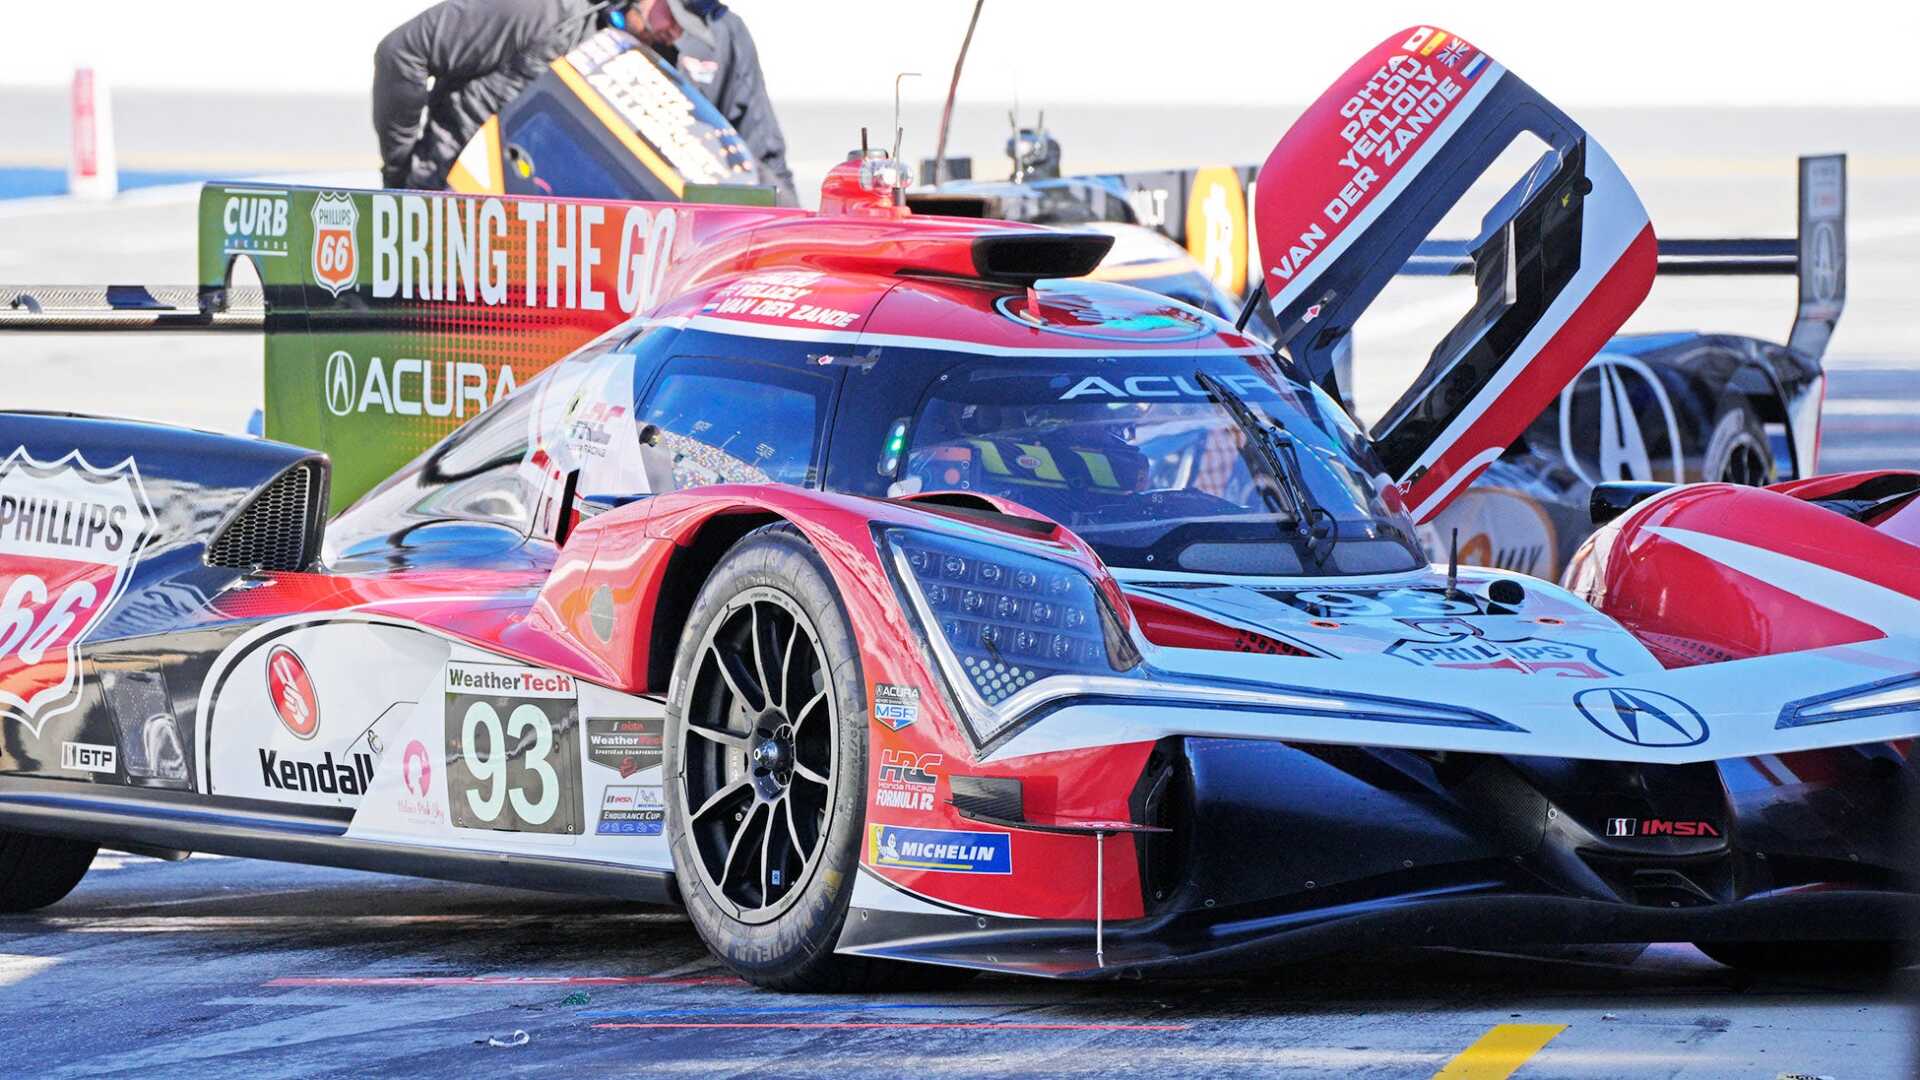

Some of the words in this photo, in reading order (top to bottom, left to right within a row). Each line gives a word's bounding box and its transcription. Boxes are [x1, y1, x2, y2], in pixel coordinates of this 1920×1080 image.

[1340, 54, 1409, 118] OHTA
[1340, 57, 1422, 143] PALOU
[1338, 65, 1437, 170] YELLOLY
[1270, 223, 1327, 280] VAN
[1323, 165, 1379, 224] DER
[1376, 76, 1462, 166] ZANDE
[223, 196, 288, 236] CURB
[318, 207, 351, 226] PHILLIPS
[320, 235, 350, 272] 66
[372, 194, 507, 306] BRING
[518, 200, 605, 311] THE
[716, 297, 755, 314] VAN
[750, 301, 795, 317] DER
[788, 304, 860, 328] ZANDE
[357, 356, 518, 418] ACURA
[0, 494, 127, 552] PHILLIPS
[0, 575, 97, 665] 66
[1411, 644, 1574, 661] PHILIPS
[450, 668, 570, 692] WeatherTech
[883, 687, 919, 698] ACURA
[876, 706, 916, 718] MSR
[80, 748, 112, 766] GTP
[259, 748, 374, 795] Kendall
[462, 701, 560, 825] 93
[879, 749, 943, 785] HRC
[875, 790, 918, 809] FORMULA
[1641, 820, 1719, 836] IMSA
[901, 842, 995, 861] MICHELIN
